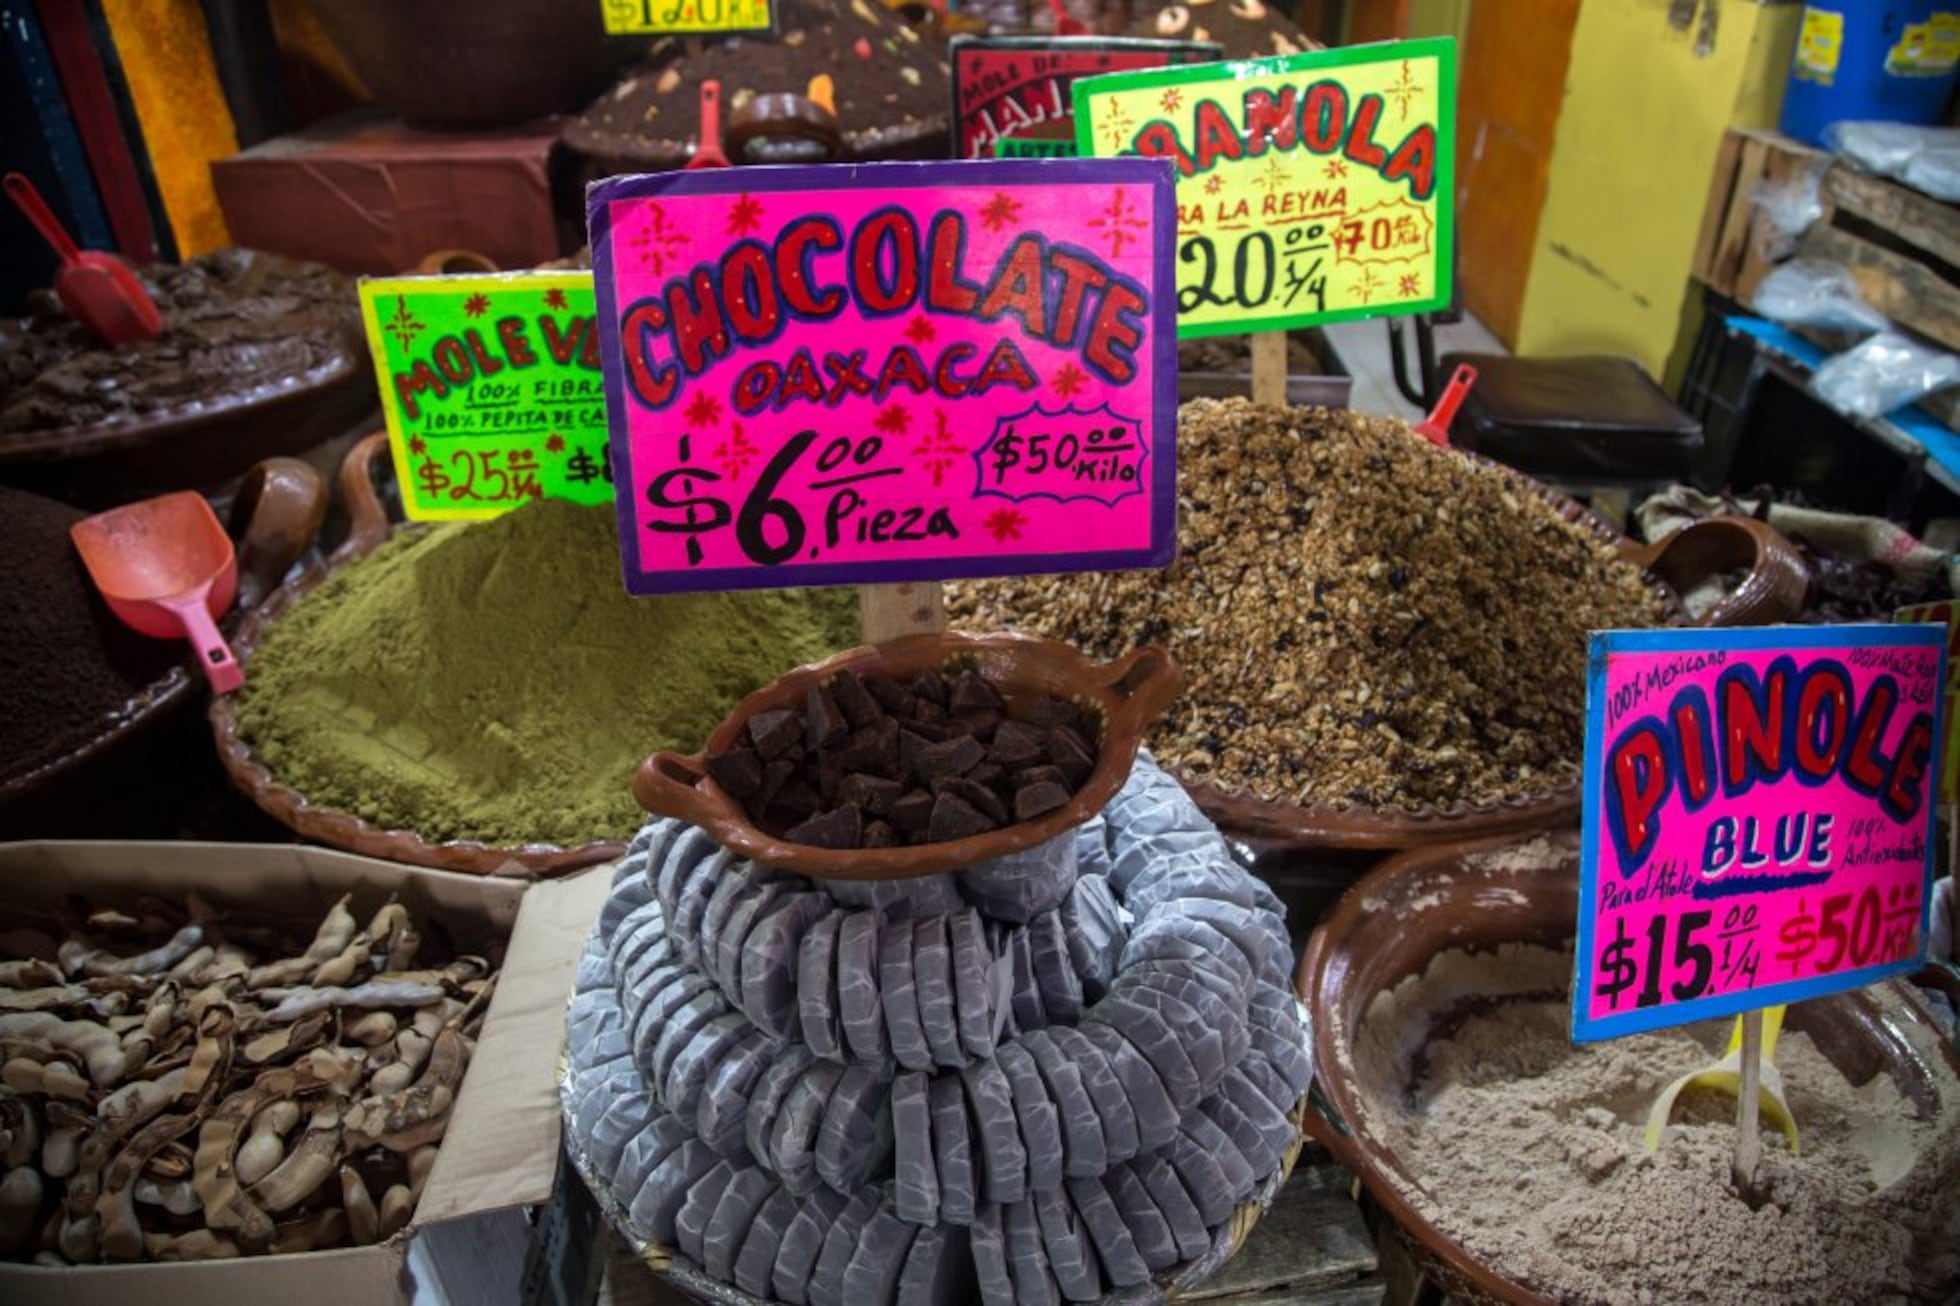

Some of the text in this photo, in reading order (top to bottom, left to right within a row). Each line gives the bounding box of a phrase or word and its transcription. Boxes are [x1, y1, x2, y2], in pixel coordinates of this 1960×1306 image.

[1118, 79, 1437, 201] RANOLA
[1216, 199, 1249, 222] LA
[1262, 188, 1347, 216] REYNA
[620, 204, 1149, 412] CHOCOLATE
[394, 316, 539, 421] MOLE
[467, 383, 520, 402] 100%
[734, 339, 1040, 414] OAXACA
[426, 413, 474, 430] 100%
[481, 410, 547, 428] PEPITA
[553, 411, 575, 424] DE
[1074, 455, 1135, 482] Kilo
[826, 488, 960, 548] Pieza
[1608, 650, 1726, 730] 100% Mexicano
[1604, 655, 1933, 879] PINOLE
[1701, 812, 1837, 879] BLUE
[1719, 938, 1760, 989] 1/4
